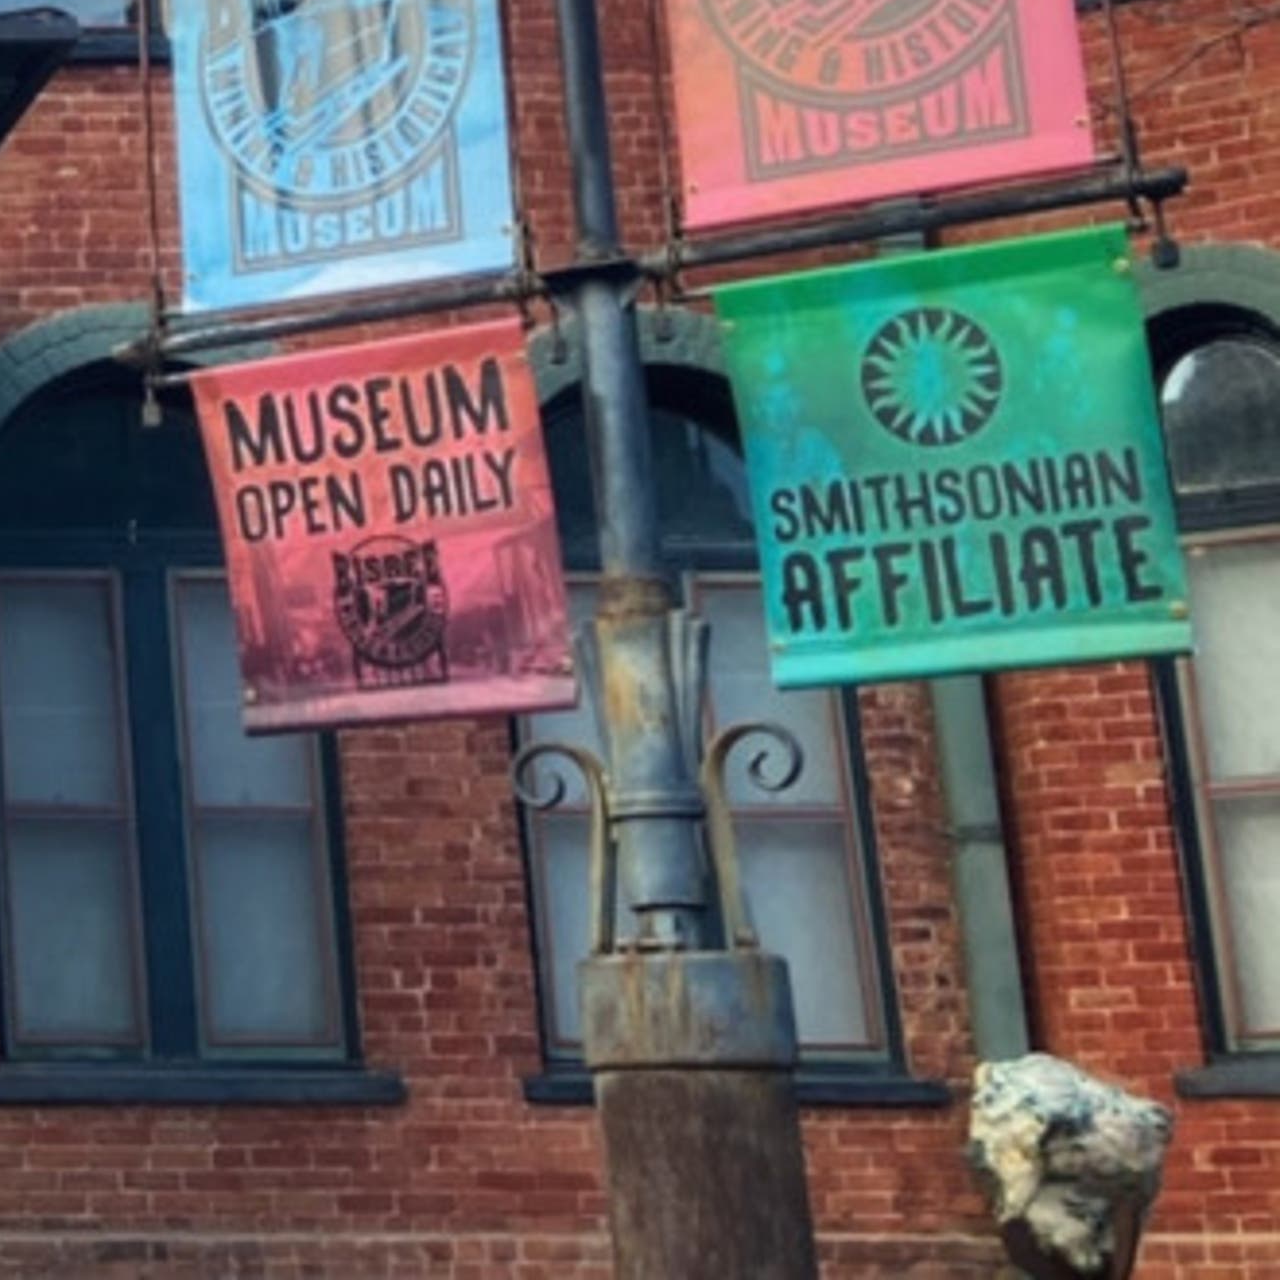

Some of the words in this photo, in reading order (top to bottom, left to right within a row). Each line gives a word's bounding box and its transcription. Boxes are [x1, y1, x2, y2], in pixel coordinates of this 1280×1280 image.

[757, 39, 1013, 164] MUSEUM
[243, 154, 449, 261] MUSEUM
[223, 357, 509, 472] MUSEUM
[236, 470, 365, 542] OPEN
[389, 448, 515, 523] DAILY
[770, 447, 1142, 543] SMITHSONIAN
[782, 516, 1163, 634] AFFILIATE
